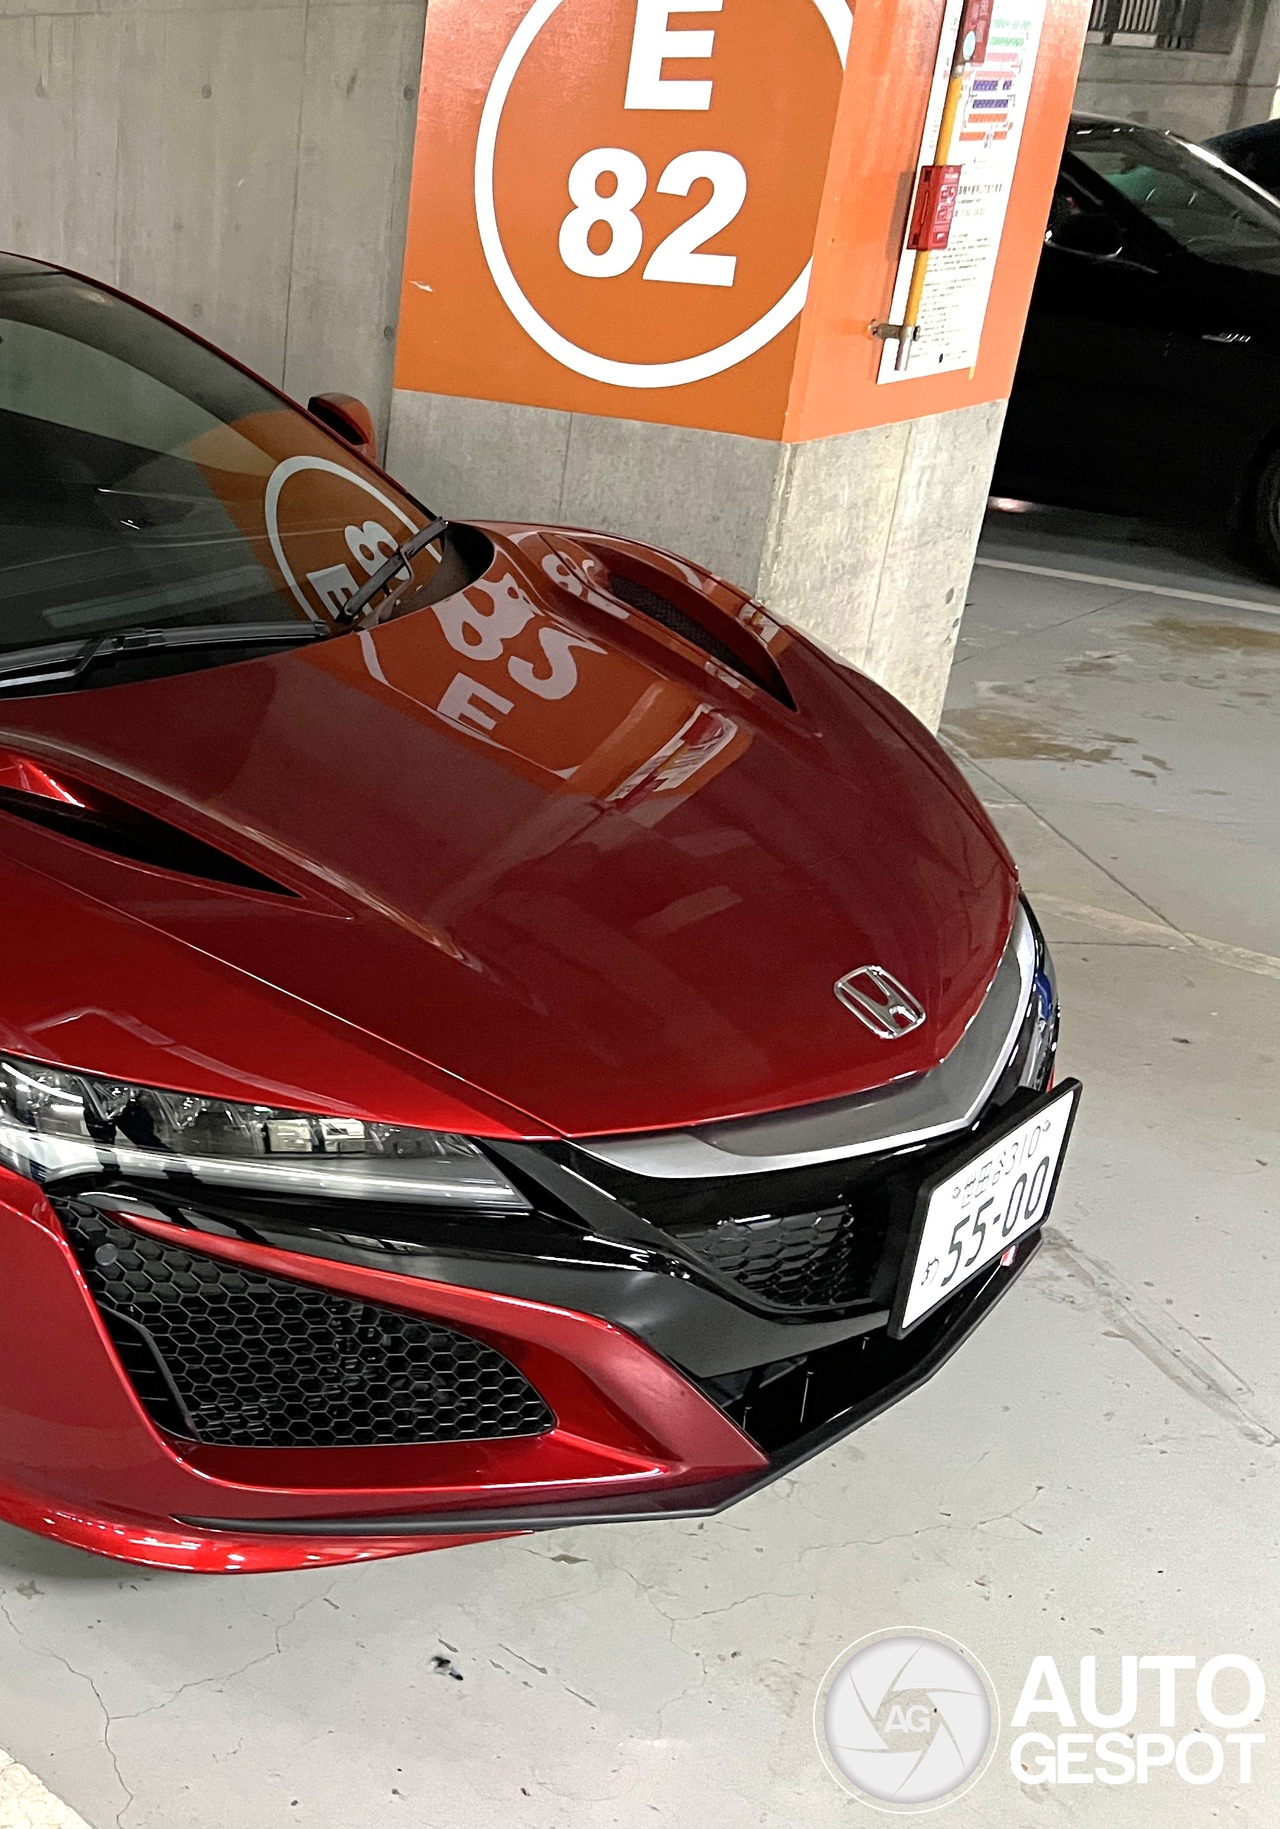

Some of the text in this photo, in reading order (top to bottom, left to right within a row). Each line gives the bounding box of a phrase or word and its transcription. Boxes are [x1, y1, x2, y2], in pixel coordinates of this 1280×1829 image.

[624, 0, 723, 111] E
[558, 147, 748, 288] 82
[941, 1156, 1050, 1288] 55-00
